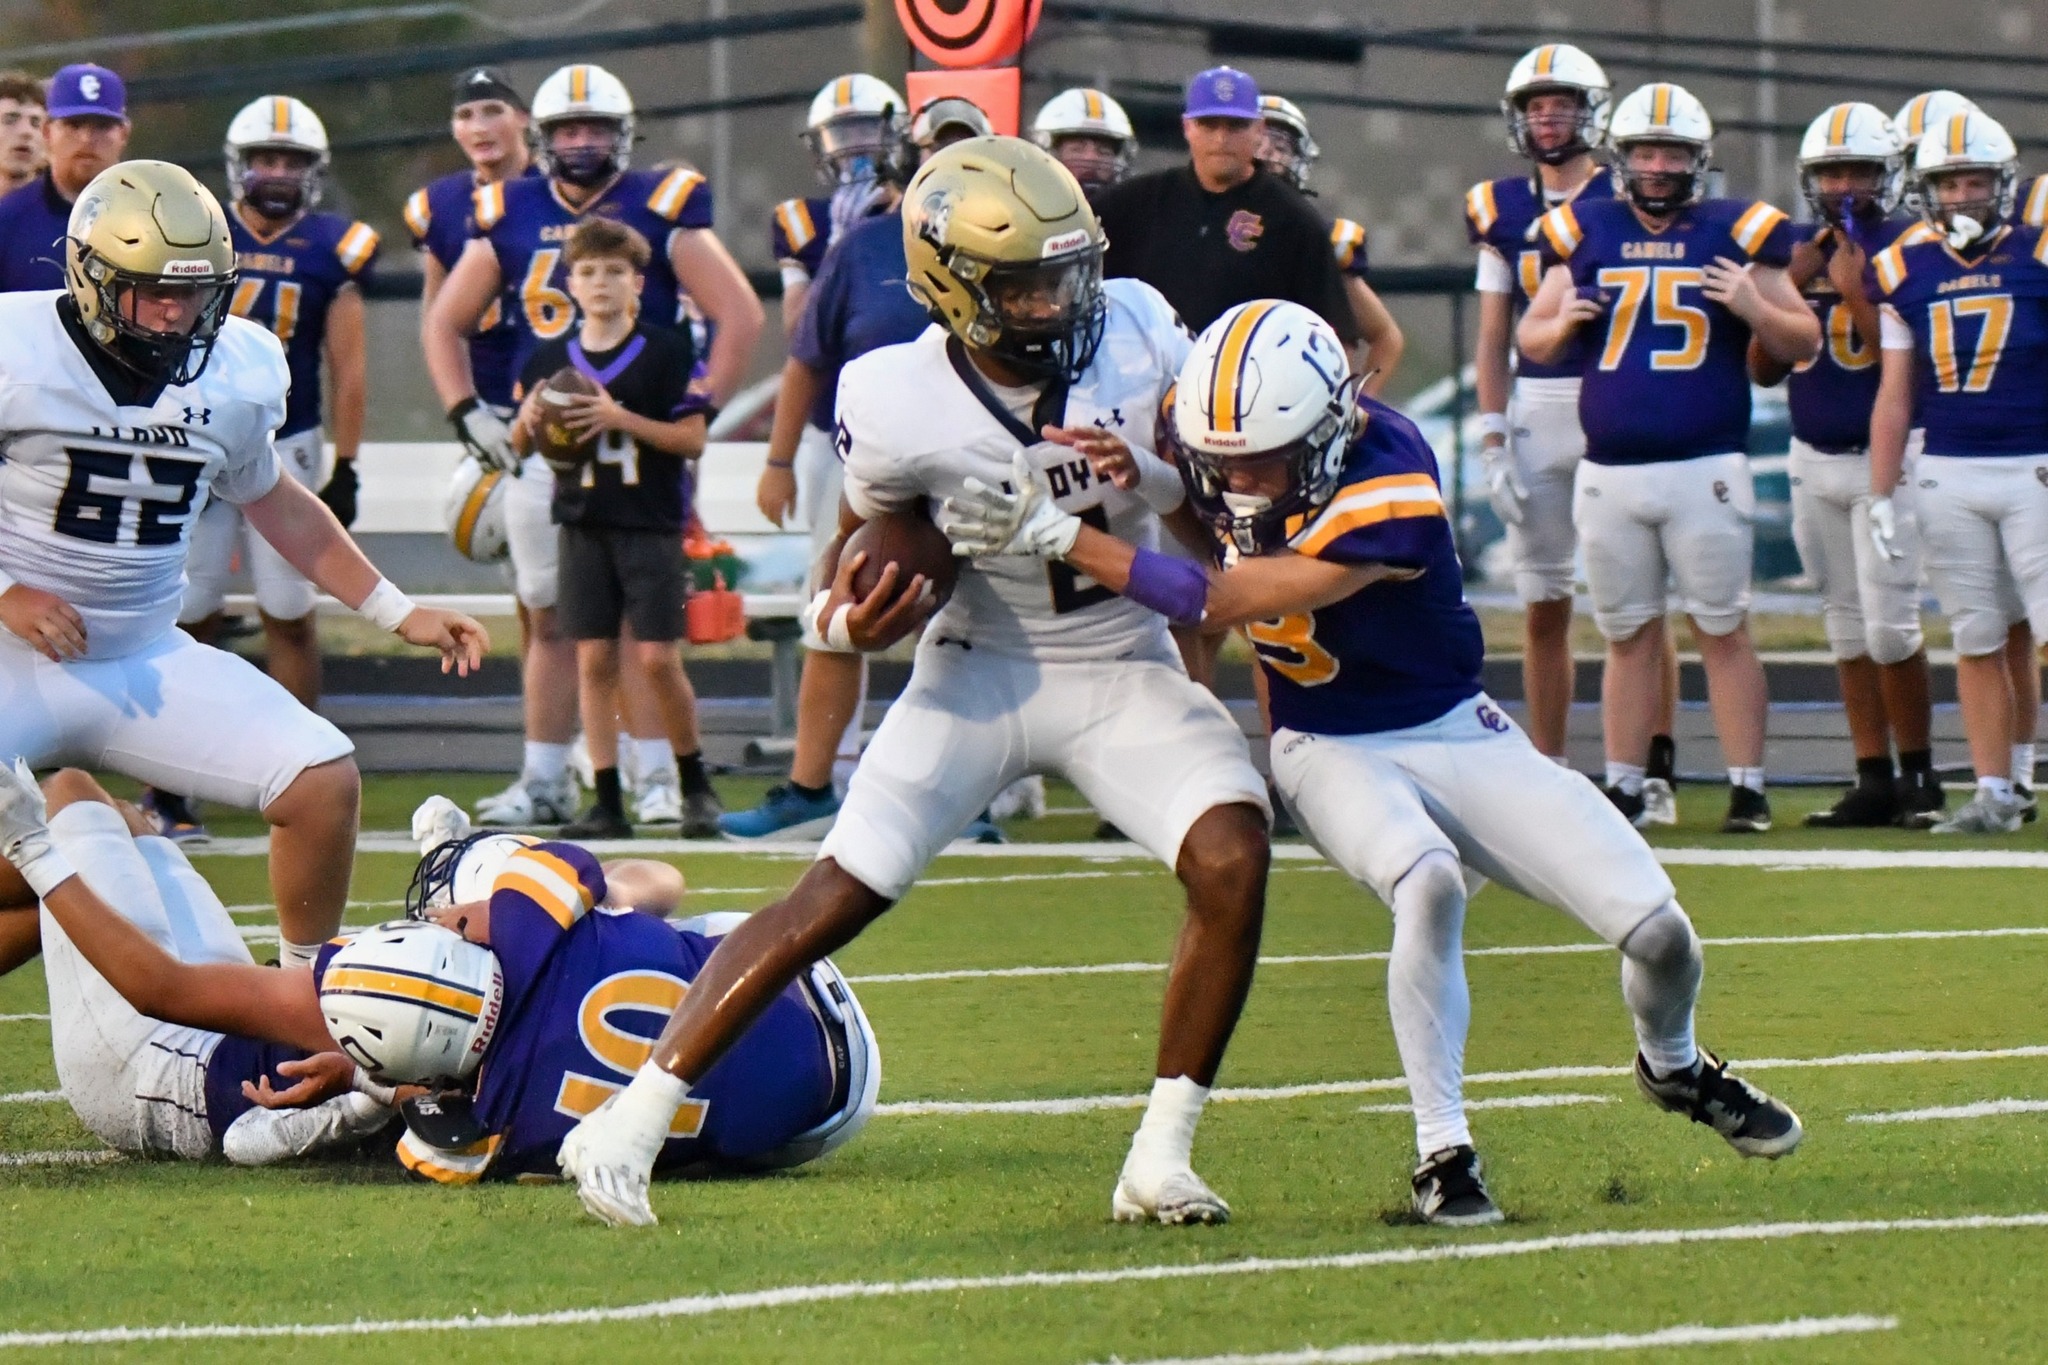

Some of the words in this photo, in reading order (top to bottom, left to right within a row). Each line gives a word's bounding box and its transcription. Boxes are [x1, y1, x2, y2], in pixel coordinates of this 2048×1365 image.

[1597, 266, 1710, 371] 75
[1928, 294, 2014, 392] 17
[54, 447, 207, 545] 62
[471, 971, 503, 1054] Riddell
